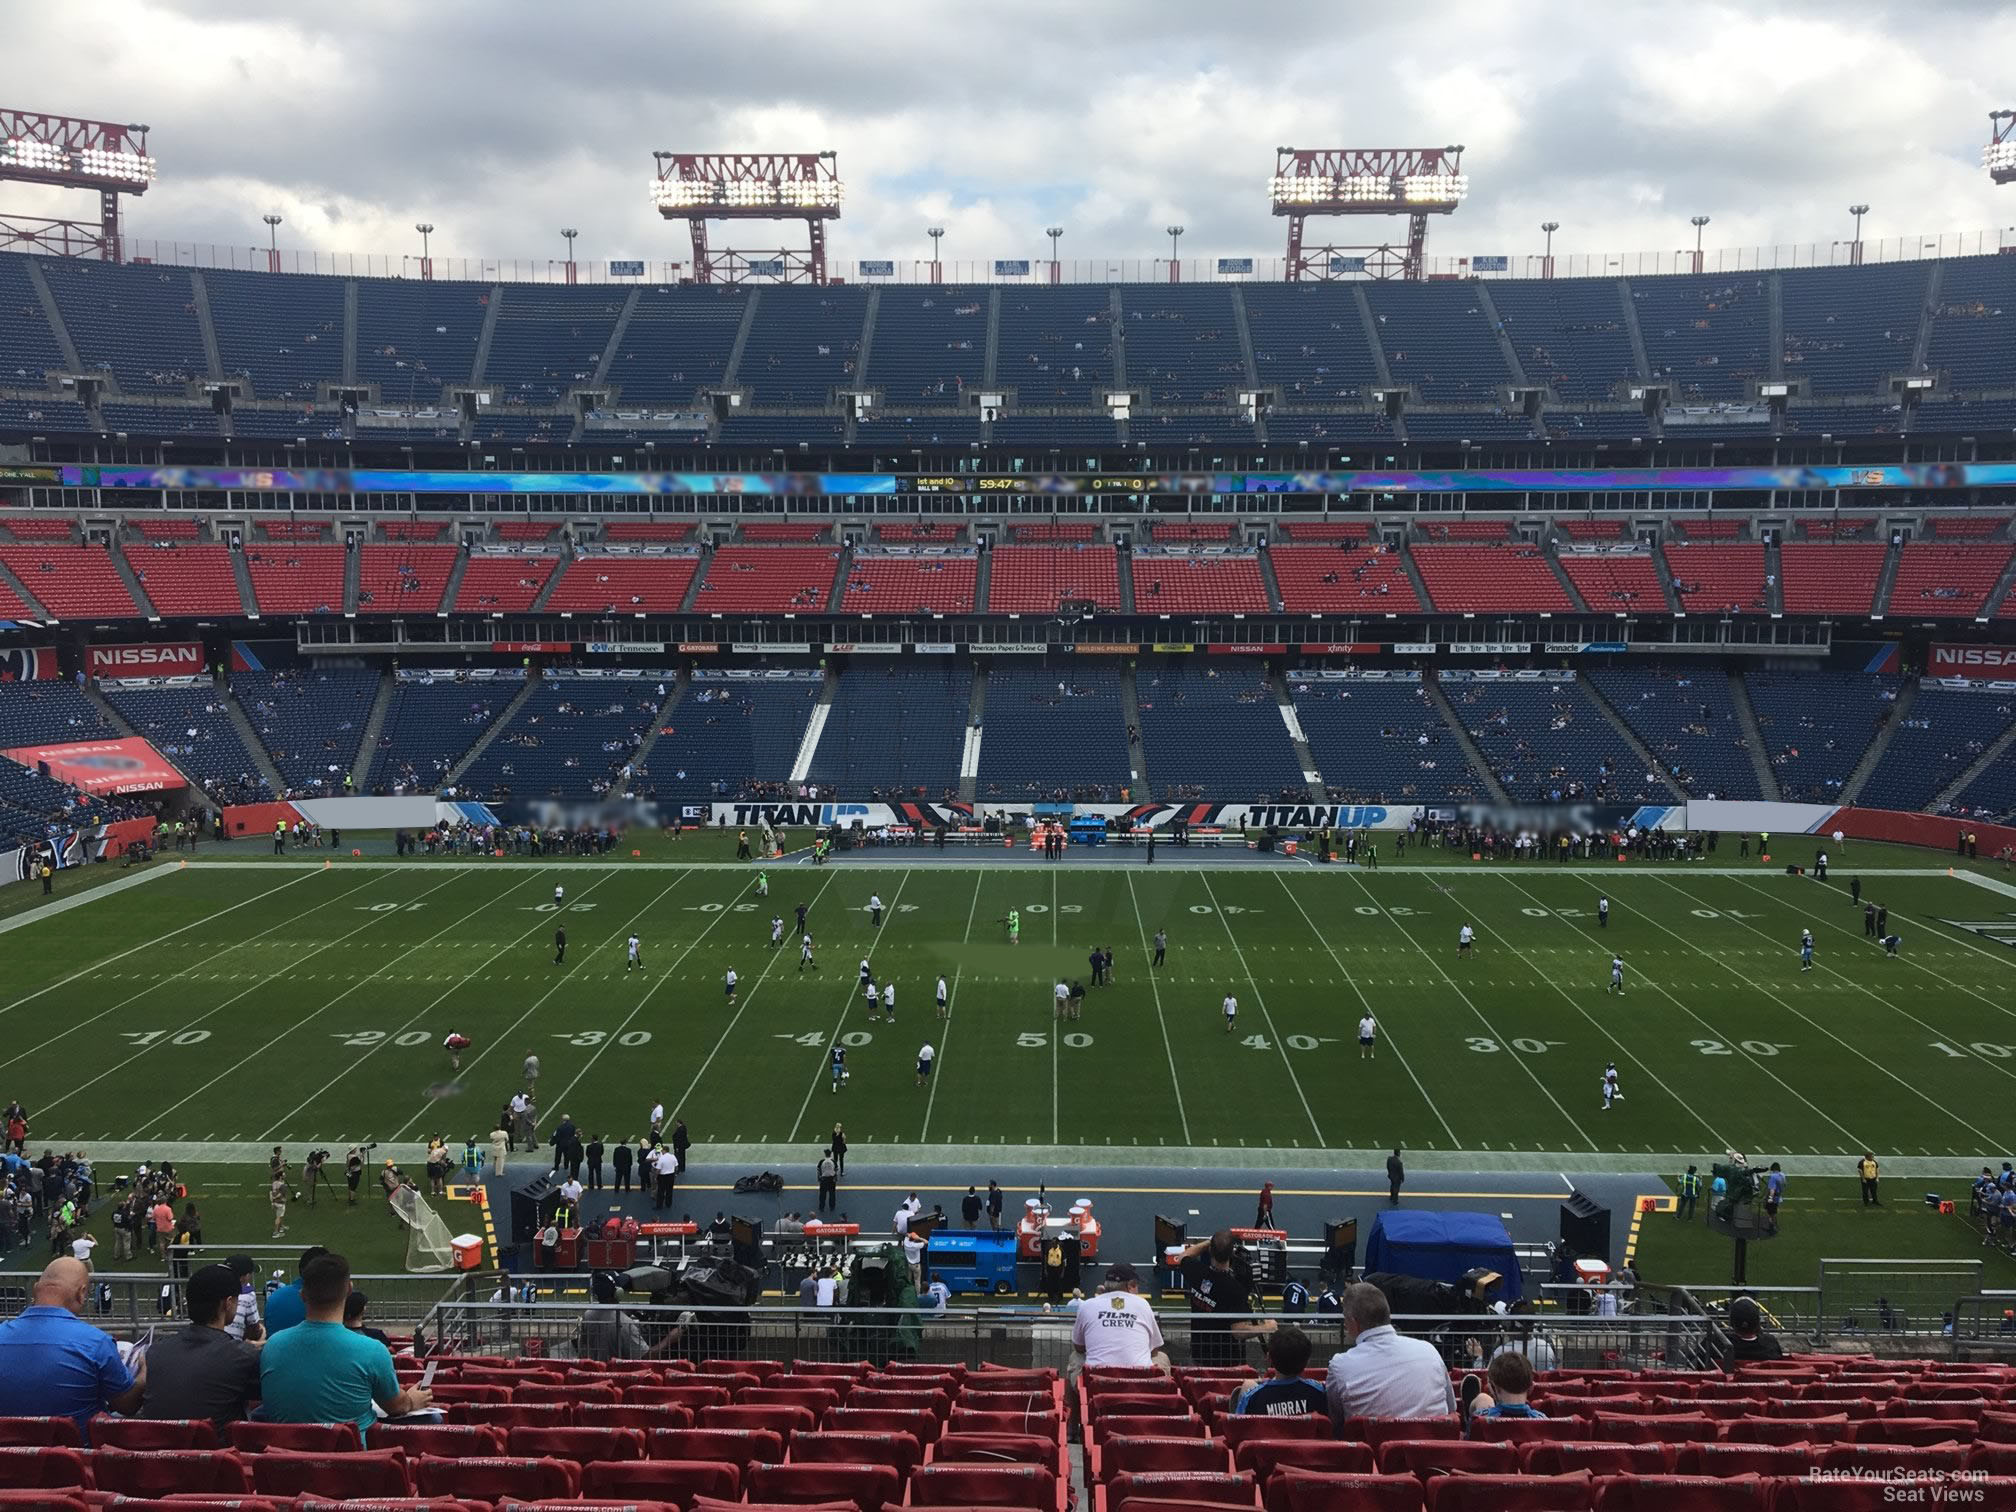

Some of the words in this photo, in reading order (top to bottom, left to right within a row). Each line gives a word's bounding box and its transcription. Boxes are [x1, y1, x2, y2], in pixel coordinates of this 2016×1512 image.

[980, 480, 1012, 489] 59:47
[619, 643, 659, 652] Tennessee
[971, 644, 997, 652] American
[998, 644, 1015, 653] Paper
[1020, 644, 1035, 652] Twine
[1327, 644, 1353, 653] xfinity
[1546, 643, 1579, 652] Pinnacle
[93, 647, 197, 665] NISSAN
[116, 782, 163, 793] NISSAN
[1249, 806, 1387, 827] TITANUP
[133, 1031, 212, 1046] 10
[343, 1031, 432, 1046] 20
[570, 1031, 653, 1047] 30
[796, 1031, 873, 1048] 40
[1016, 1032, 1094, 1048] 50
[1241, 1034, 1319, 1051] 40
[1465, 1036, 1548, 1054] 30
[1691, 1039, 1780, 1056] 20
[471, 1193, 482, 1203] 30
[1644, 1200, 1656, 1211] 30
[454, 1250, 463, 1263] G
[1098, 1311, 1138, 1321] FILMS
[1102, 1319, 1135, 1328] CREW
[1266, 1399, 1308, 1416] MURRAY
